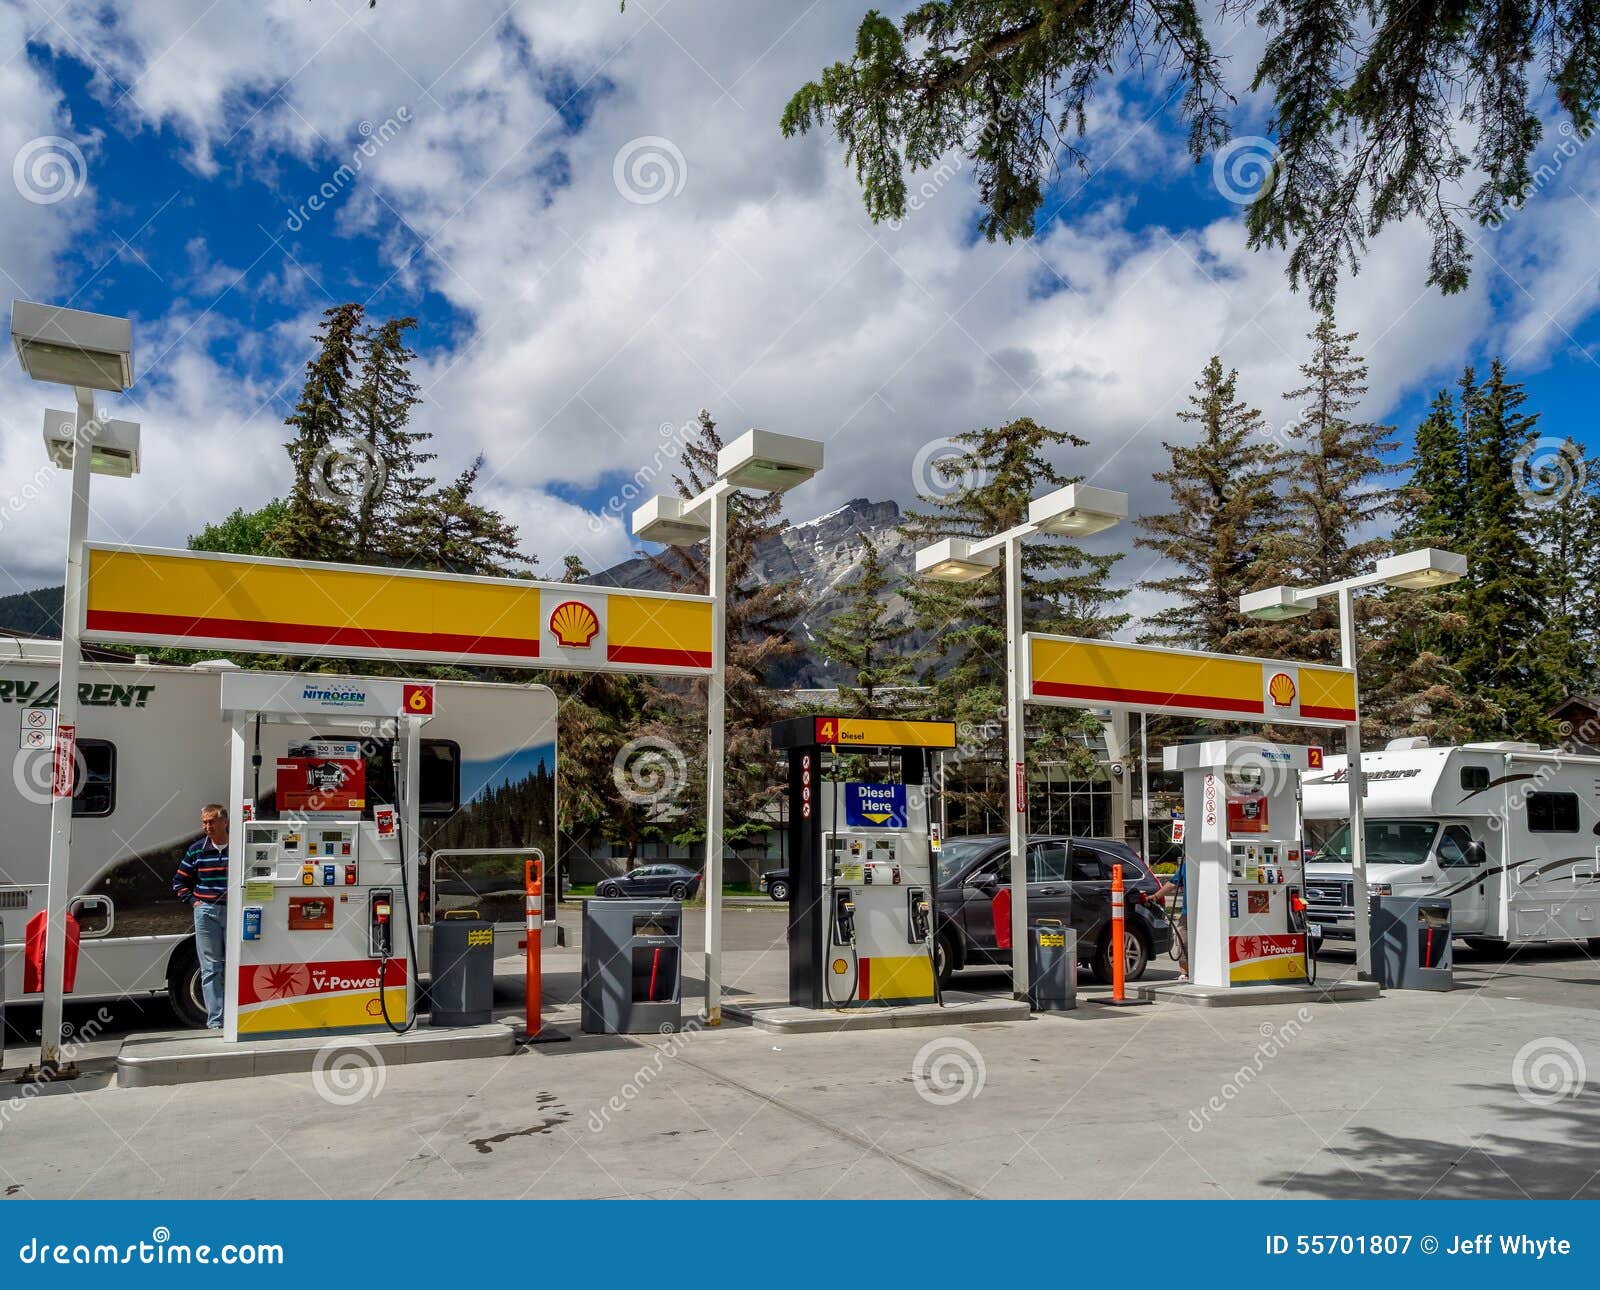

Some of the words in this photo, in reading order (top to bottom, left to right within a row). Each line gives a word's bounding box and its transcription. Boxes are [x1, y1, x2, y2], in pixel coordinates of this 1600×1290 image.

[303, 690, 366, 701] NITROGEN
[409, 690, 427, 710] 6
[821, 722, 834, 739] 4
[841, 731, 865, 740] Diesel
[1311, 751, 1320, 765] 2
[858, 786, 895, 799] Diesel
[862, 800, 892, 812] Here
[1262, 944, 1296, 954] V-Power
[312, 976, 382, 991] V-Power
